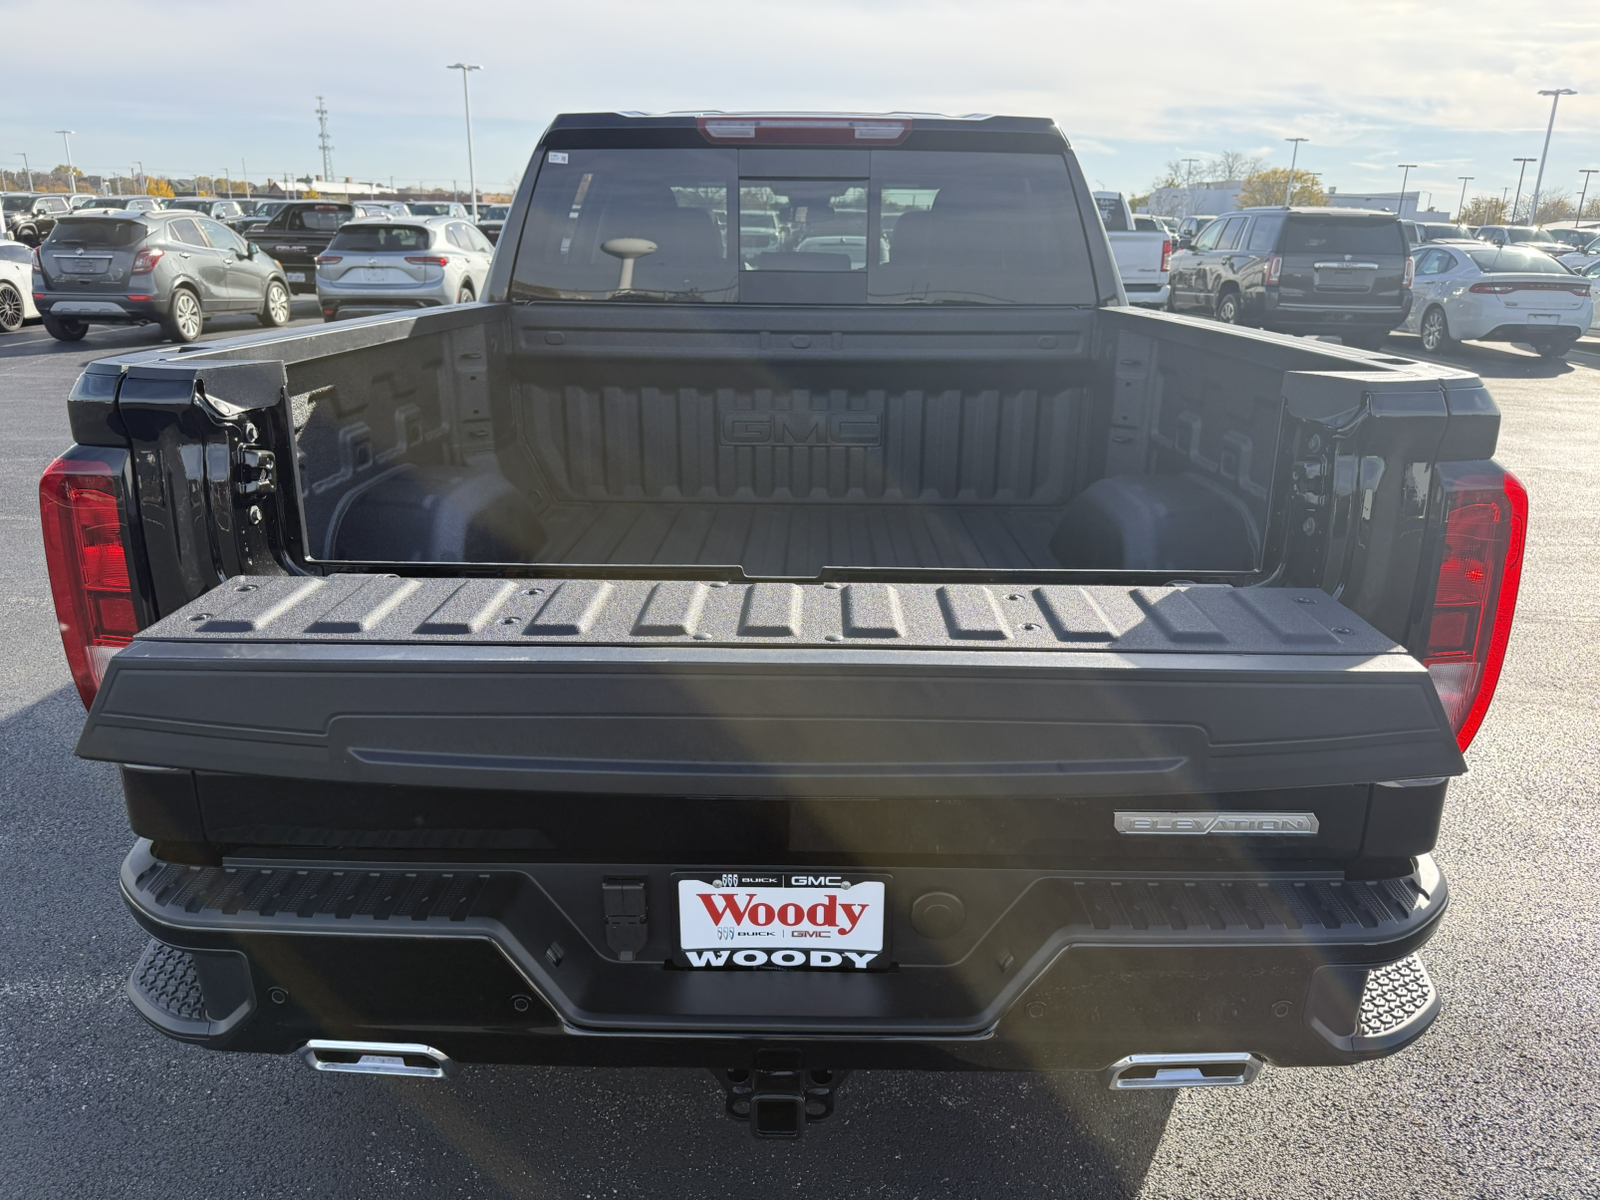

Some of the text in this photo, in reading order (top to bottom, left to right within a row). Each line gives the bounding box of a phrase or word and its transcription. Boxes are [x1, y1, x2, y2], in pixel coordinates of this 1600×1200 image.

[722, 411, 880, 444] GMC
[1130, 817, 1306, 831] ELEVATION
[791, 876, 842, 886] GMC
[696, 893, 869, 935] Woody
[791, 930, 831, 938] GMC
[686, 950, 878, 968] WOODY
